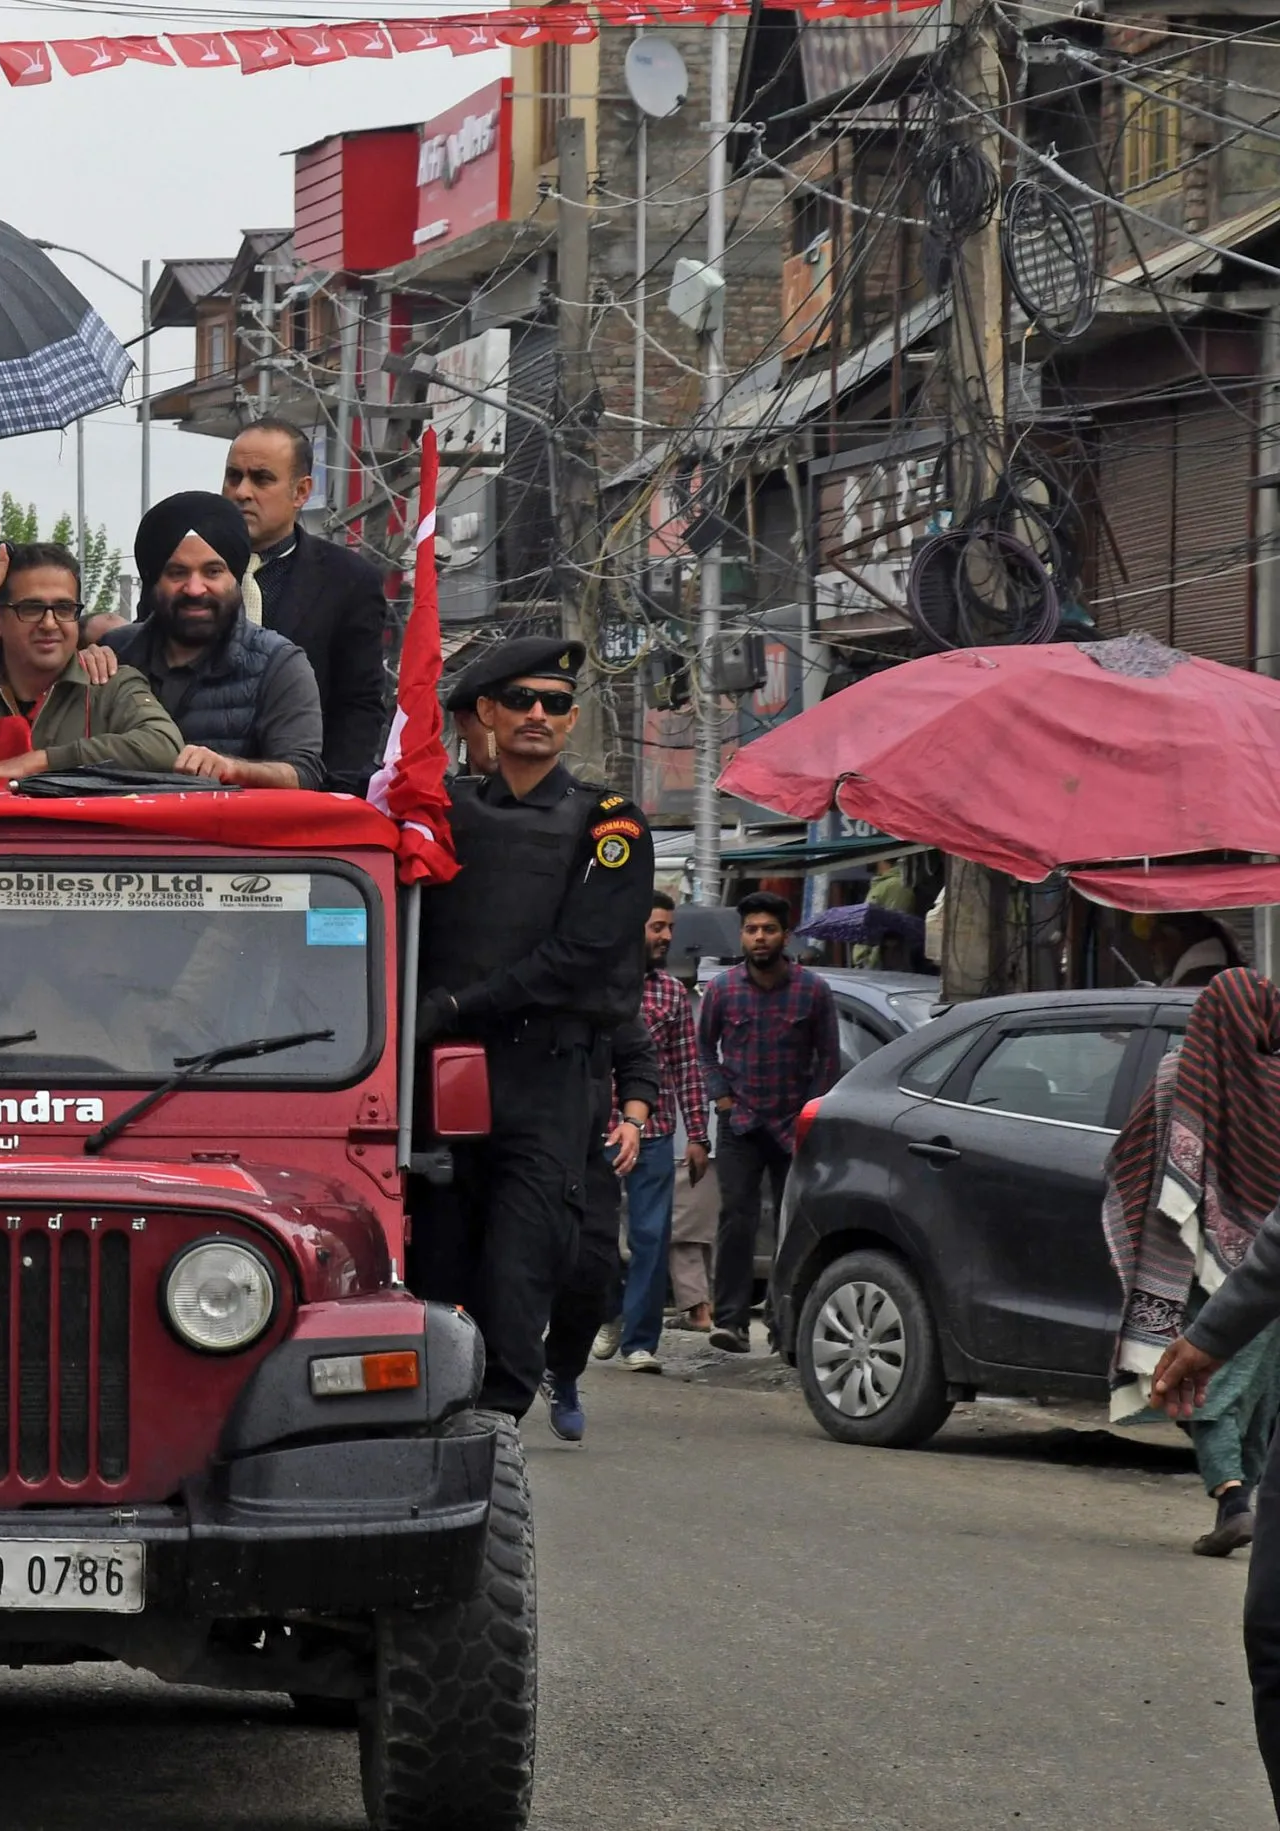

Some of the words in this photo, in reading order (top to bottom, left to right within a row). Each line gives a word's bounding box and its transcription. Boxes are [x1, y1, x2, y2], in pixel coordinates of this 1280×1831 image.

[594, 820, 640, 836] COMMANDO
[102, 873, 145, 893] (P)
[151, 874, 213, 893] Ltd.
[27, 1555, 125, 1597] 0786
